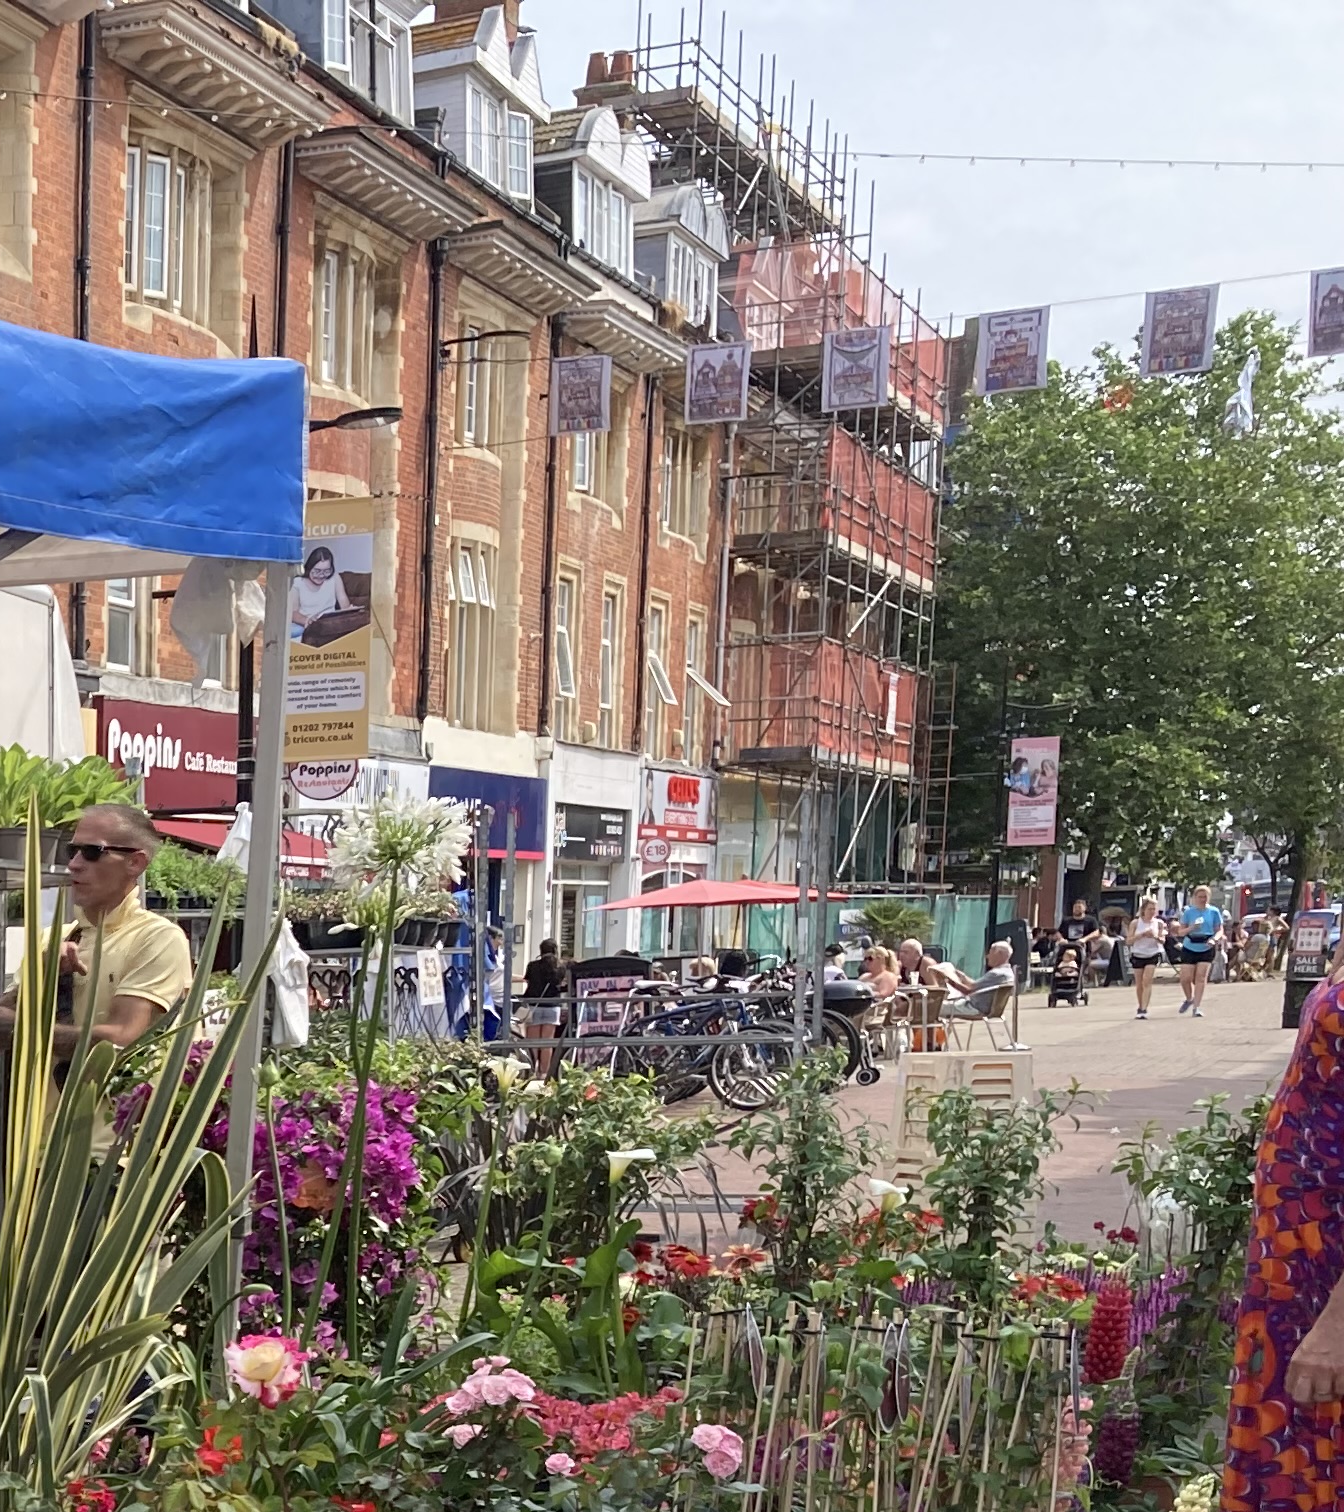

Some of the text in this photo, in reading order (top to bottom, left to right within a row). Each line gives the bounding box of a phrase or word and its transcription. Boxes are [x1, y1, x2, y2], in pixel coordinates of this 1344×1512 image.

[306, 523, 347, 537] icuro
[323, 652, 356, 661] DIGITAL
[322, 721, 355, 731] 797844
[292, 733, 354, 744] tricuro.co.uk
[108, 718, 238, 778] Poppins Café Restau
[299, 762, 352, 777] Poppins
[645, 845, 667, 856] £18
[1296, 956, 1317, 965] SALE
[1293, 965, 1318, 973] HERE
